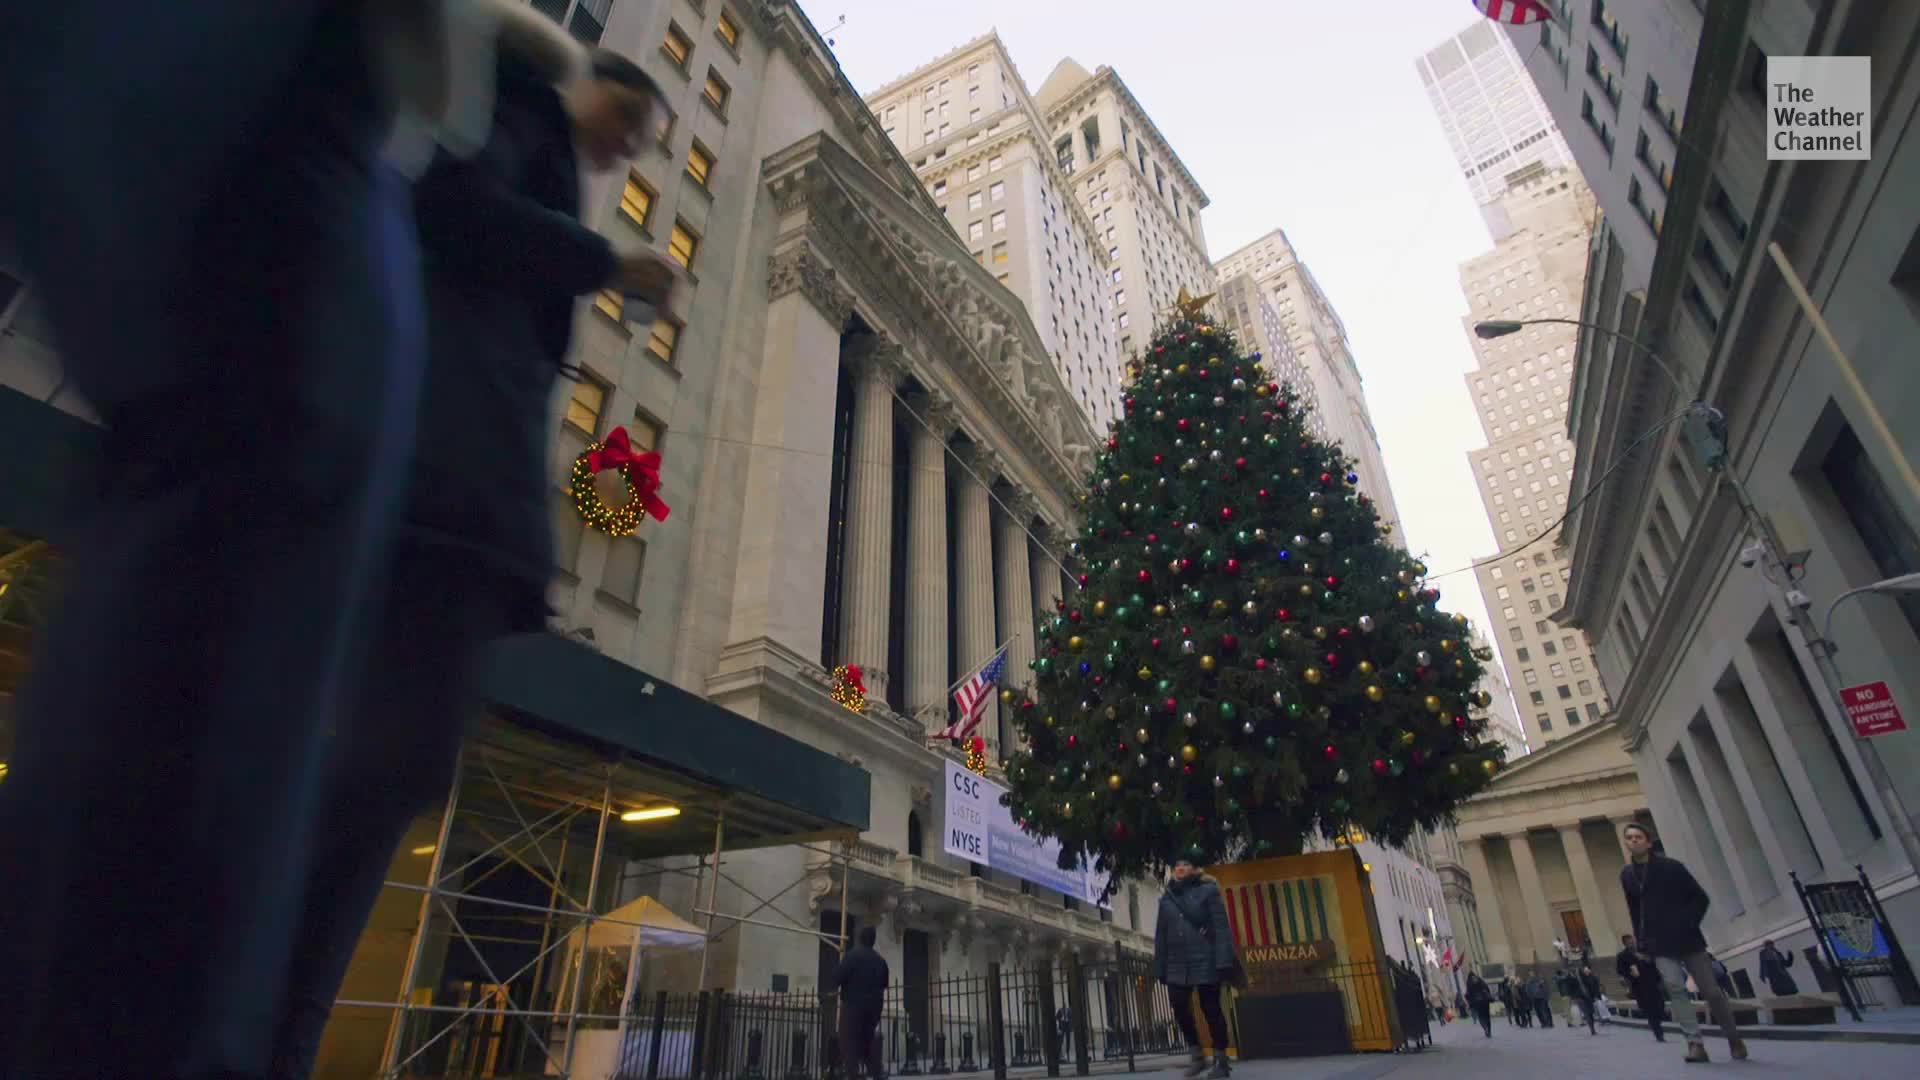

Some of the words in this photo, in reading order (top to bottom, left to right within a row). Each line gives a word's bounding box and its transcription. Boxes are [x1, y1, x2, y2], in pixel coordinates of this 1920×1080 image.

[1856, 689, 1874, 701] NO
[1848, 699, 1895, 715] STANDING
[1856, 710, 1896, 724] ANYTIME
[953, 771, 980, 799] CSC
[952, 803, 981, 825] LISTED
[952, 827, 981, 855] NYSE
[1246, 944, 1318, 963] KWANZAA
